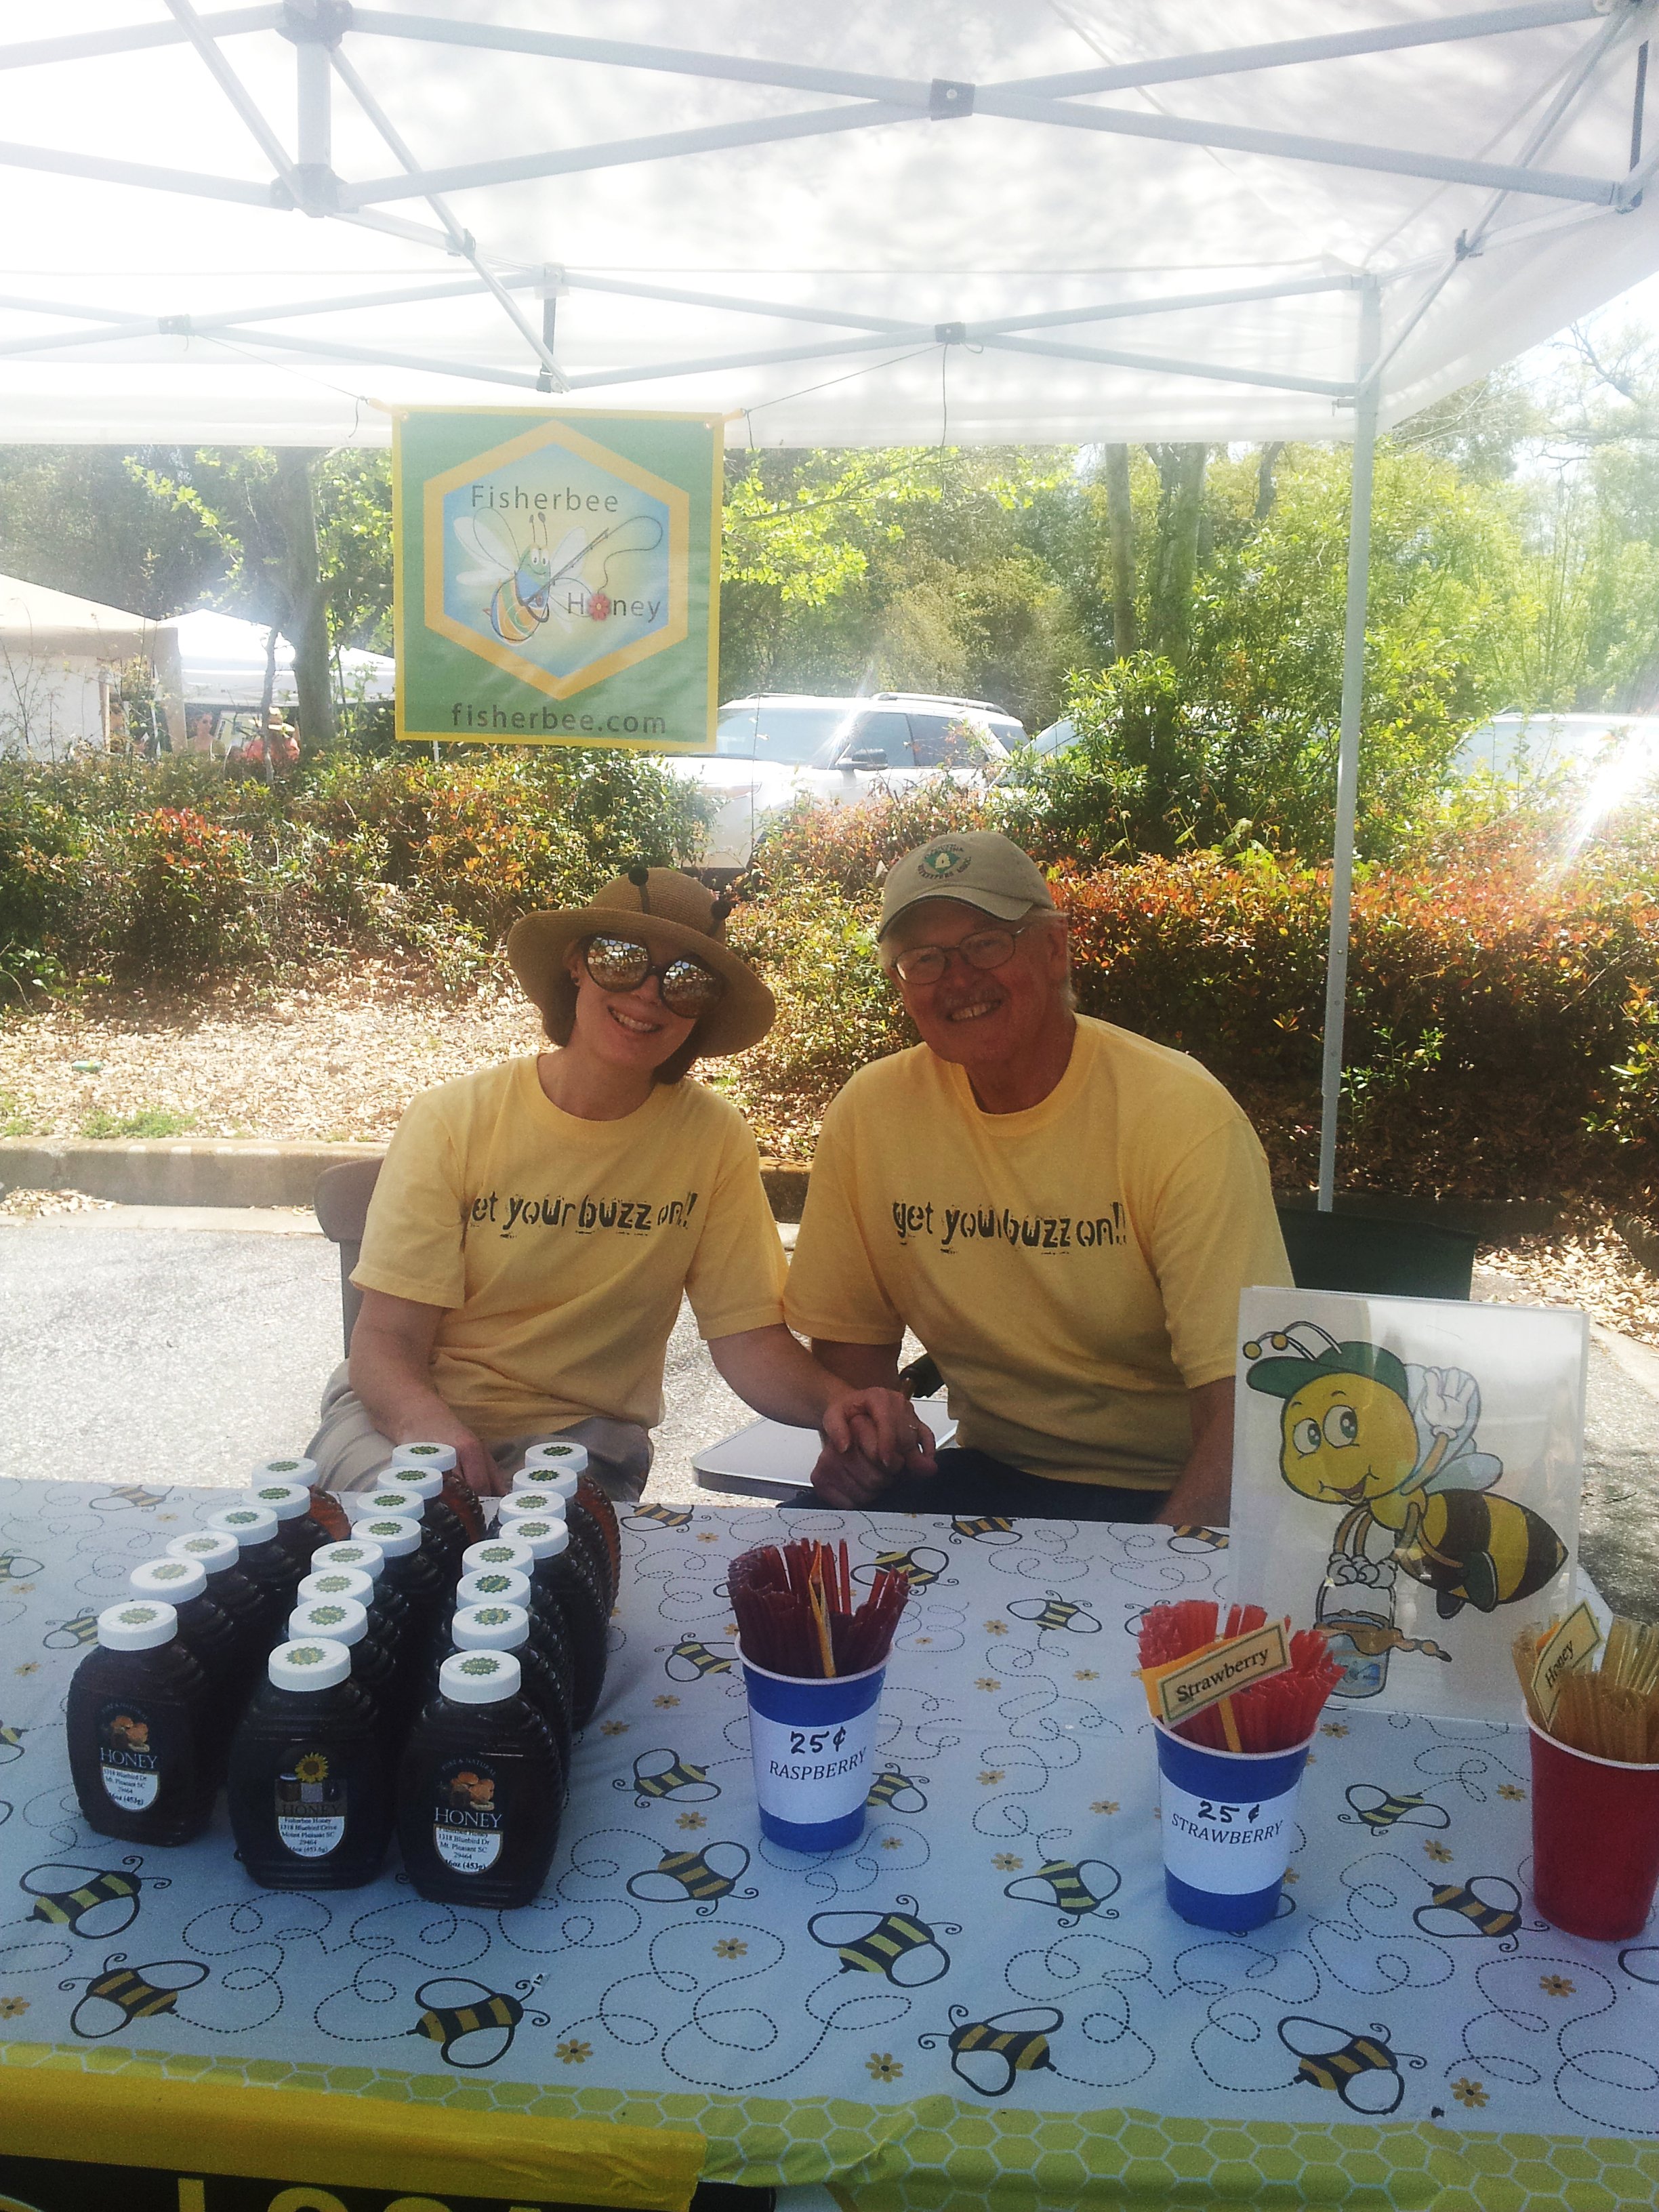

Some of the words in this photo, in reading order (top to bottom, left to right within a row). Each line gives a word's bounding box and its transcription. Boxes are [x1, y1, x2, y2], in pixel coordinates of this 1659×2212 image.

[471, 485, 619, 512] Fisherbee
[567, 592, 661, 623] Honey
[451, 702, 667, 735] fisherbee.com
[472, 1191, 499, 1222] et
[502, 1196, 576, 1231] your
[578, 1195, 652, 1231] buzz
[893, 1201, 935, 1239] get
[1003, 1208, 1071, 1248] buzz
[1176, 1647, 1269, 1703] Strawberry
[100, 1747, 157, 1769] HONEY
[769, 1746, 867, 1781] RASPBERRY
[281, 1803, 340, 1816] HONEY
[434, 1807, 502, 1828] HONEY
[1172, 1813, 1284, 1845] STRAWBERRY
